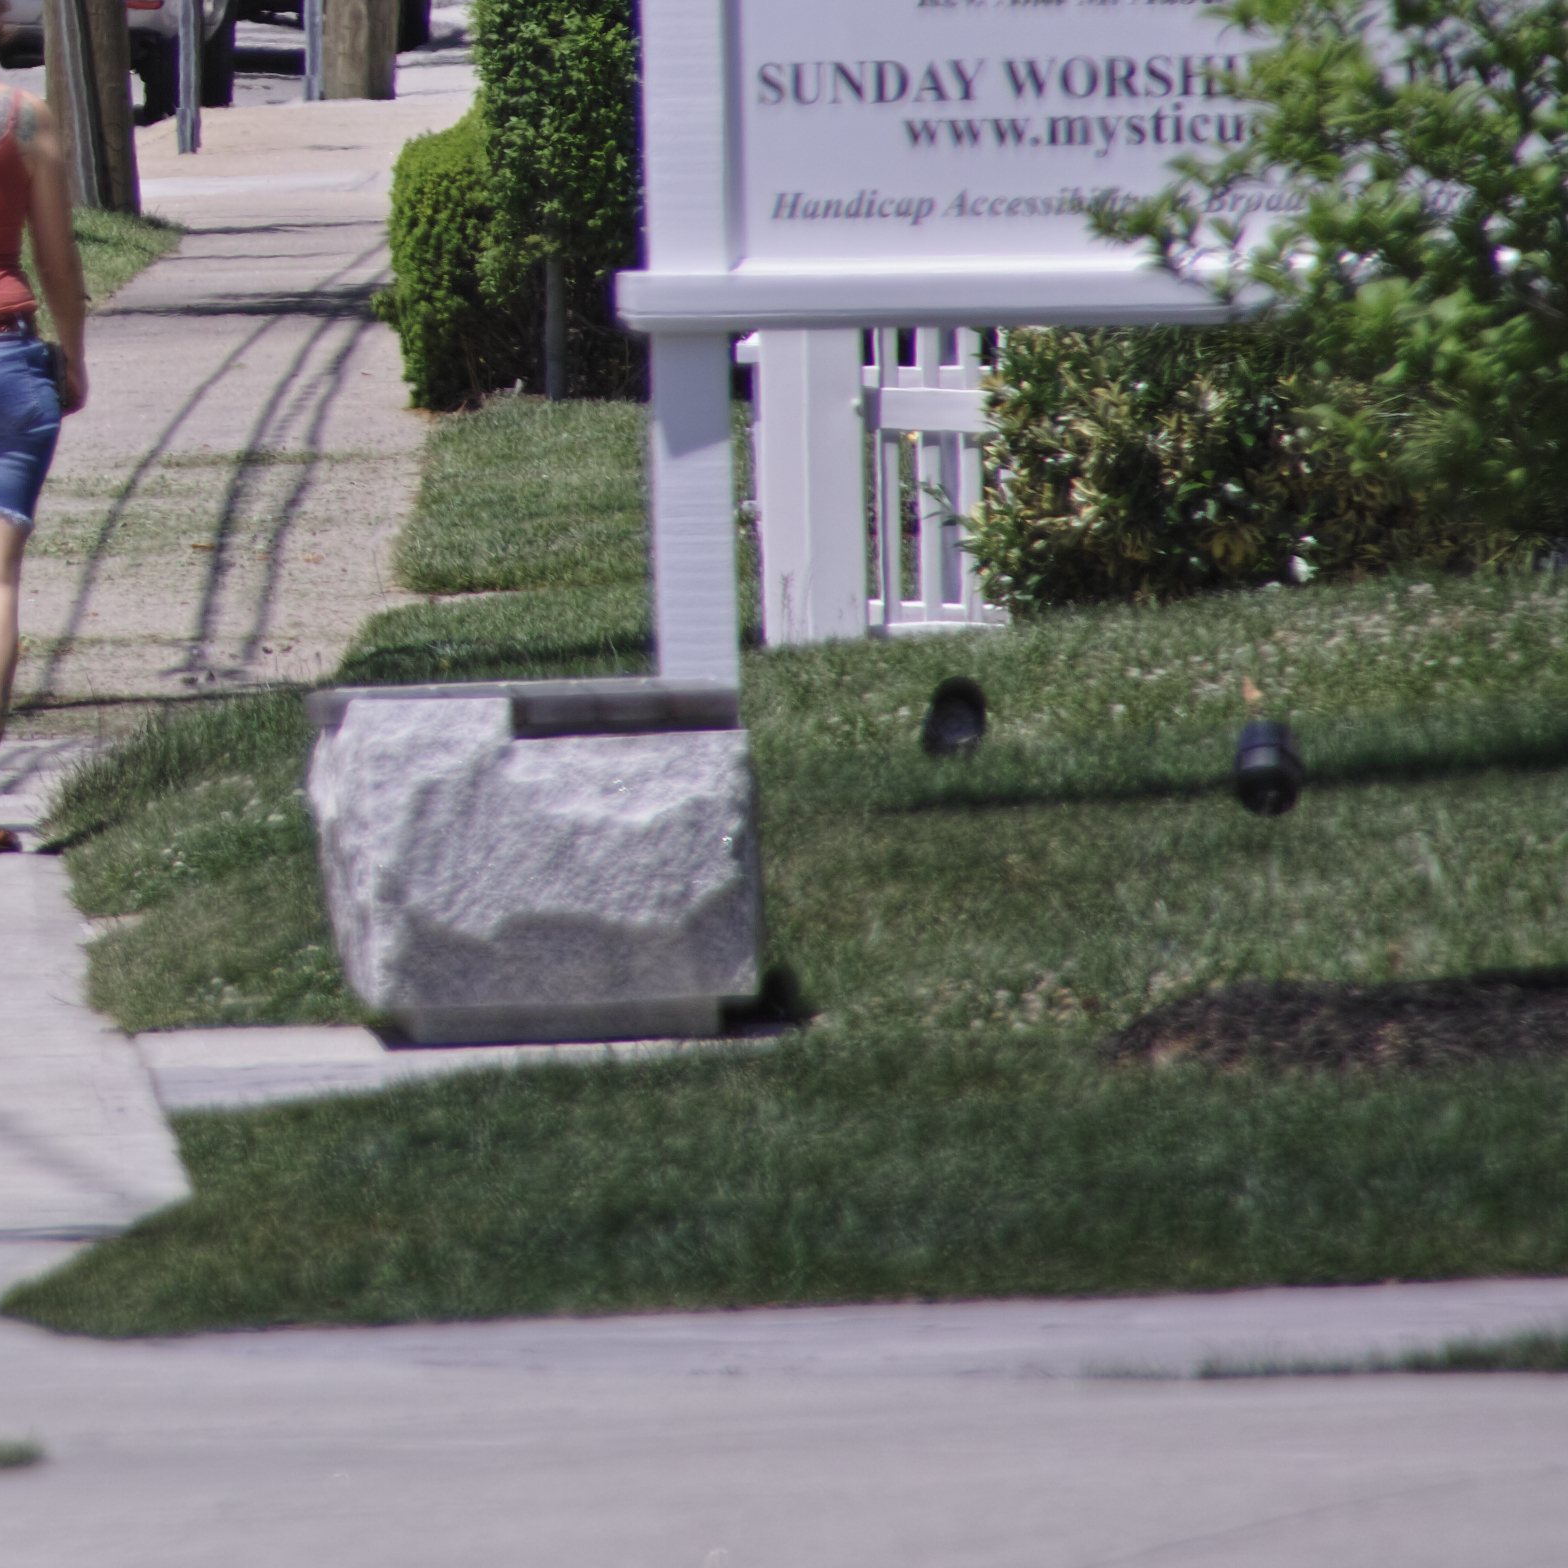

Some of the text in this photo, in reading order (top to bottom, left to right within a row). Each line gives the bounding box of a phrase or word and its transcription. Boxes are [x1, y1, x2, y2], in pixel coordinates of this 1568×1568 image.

[756, 54, 1238, 105] SUNDAY WORSHI
[903, 101, 1250, 158] www.mysticu
[771, 190, 935, 225] Handicap
